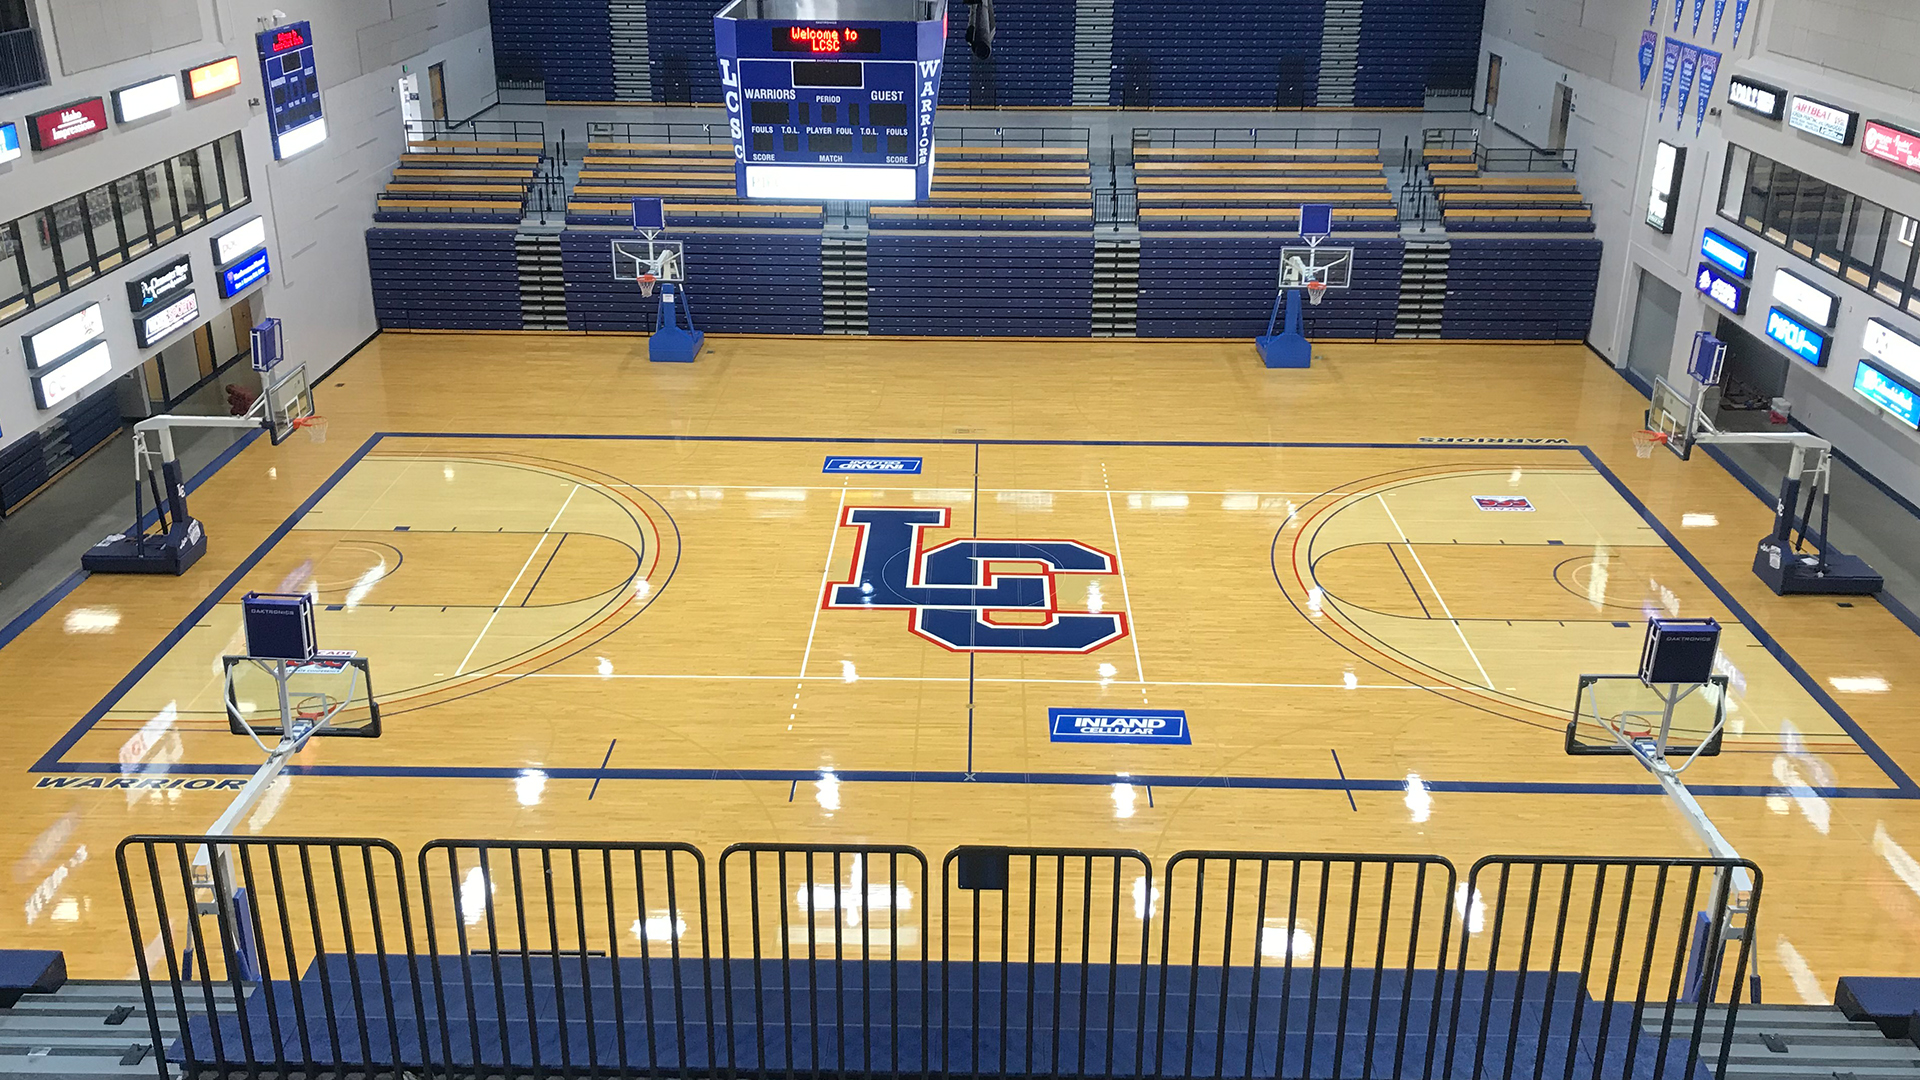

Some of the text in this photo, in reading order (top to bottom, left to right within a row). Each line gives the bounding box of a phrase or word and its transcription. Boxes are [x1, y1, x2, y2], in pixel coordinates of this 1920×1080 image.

[791, 27, 858, 40] Welcome to
[813, 39, 840, 51] LCSC
[744, 88, 796, 100] WARRIORS
[870, 90, 904, 101] GUEST
[816, 95, 841, 103] PERIOD
[919, 59, 941, 164] WARRIORS
[1794, 103, 1831, 120] ARTBEAT
[61, 109, 82, 123] Idaho
[52, 119, 96, 140] Impressions
[703, 123, 709, 131] K
[751, 126, 774, 134] FOULS
[781, 126, 800, 134] T.O.L.
[806, 127, 854, 135] PLAYER FOUL
[860, 127, 879, 135] T.O.L.
[886, 128, 908, 136] FOULS
[752, 153, 776, 161] SCORE
[886, 155, 909, 163] SCORE
[1074, 717, 1166, 729] INLAND
[1080, 727, 1154, 735] CELLULAR
